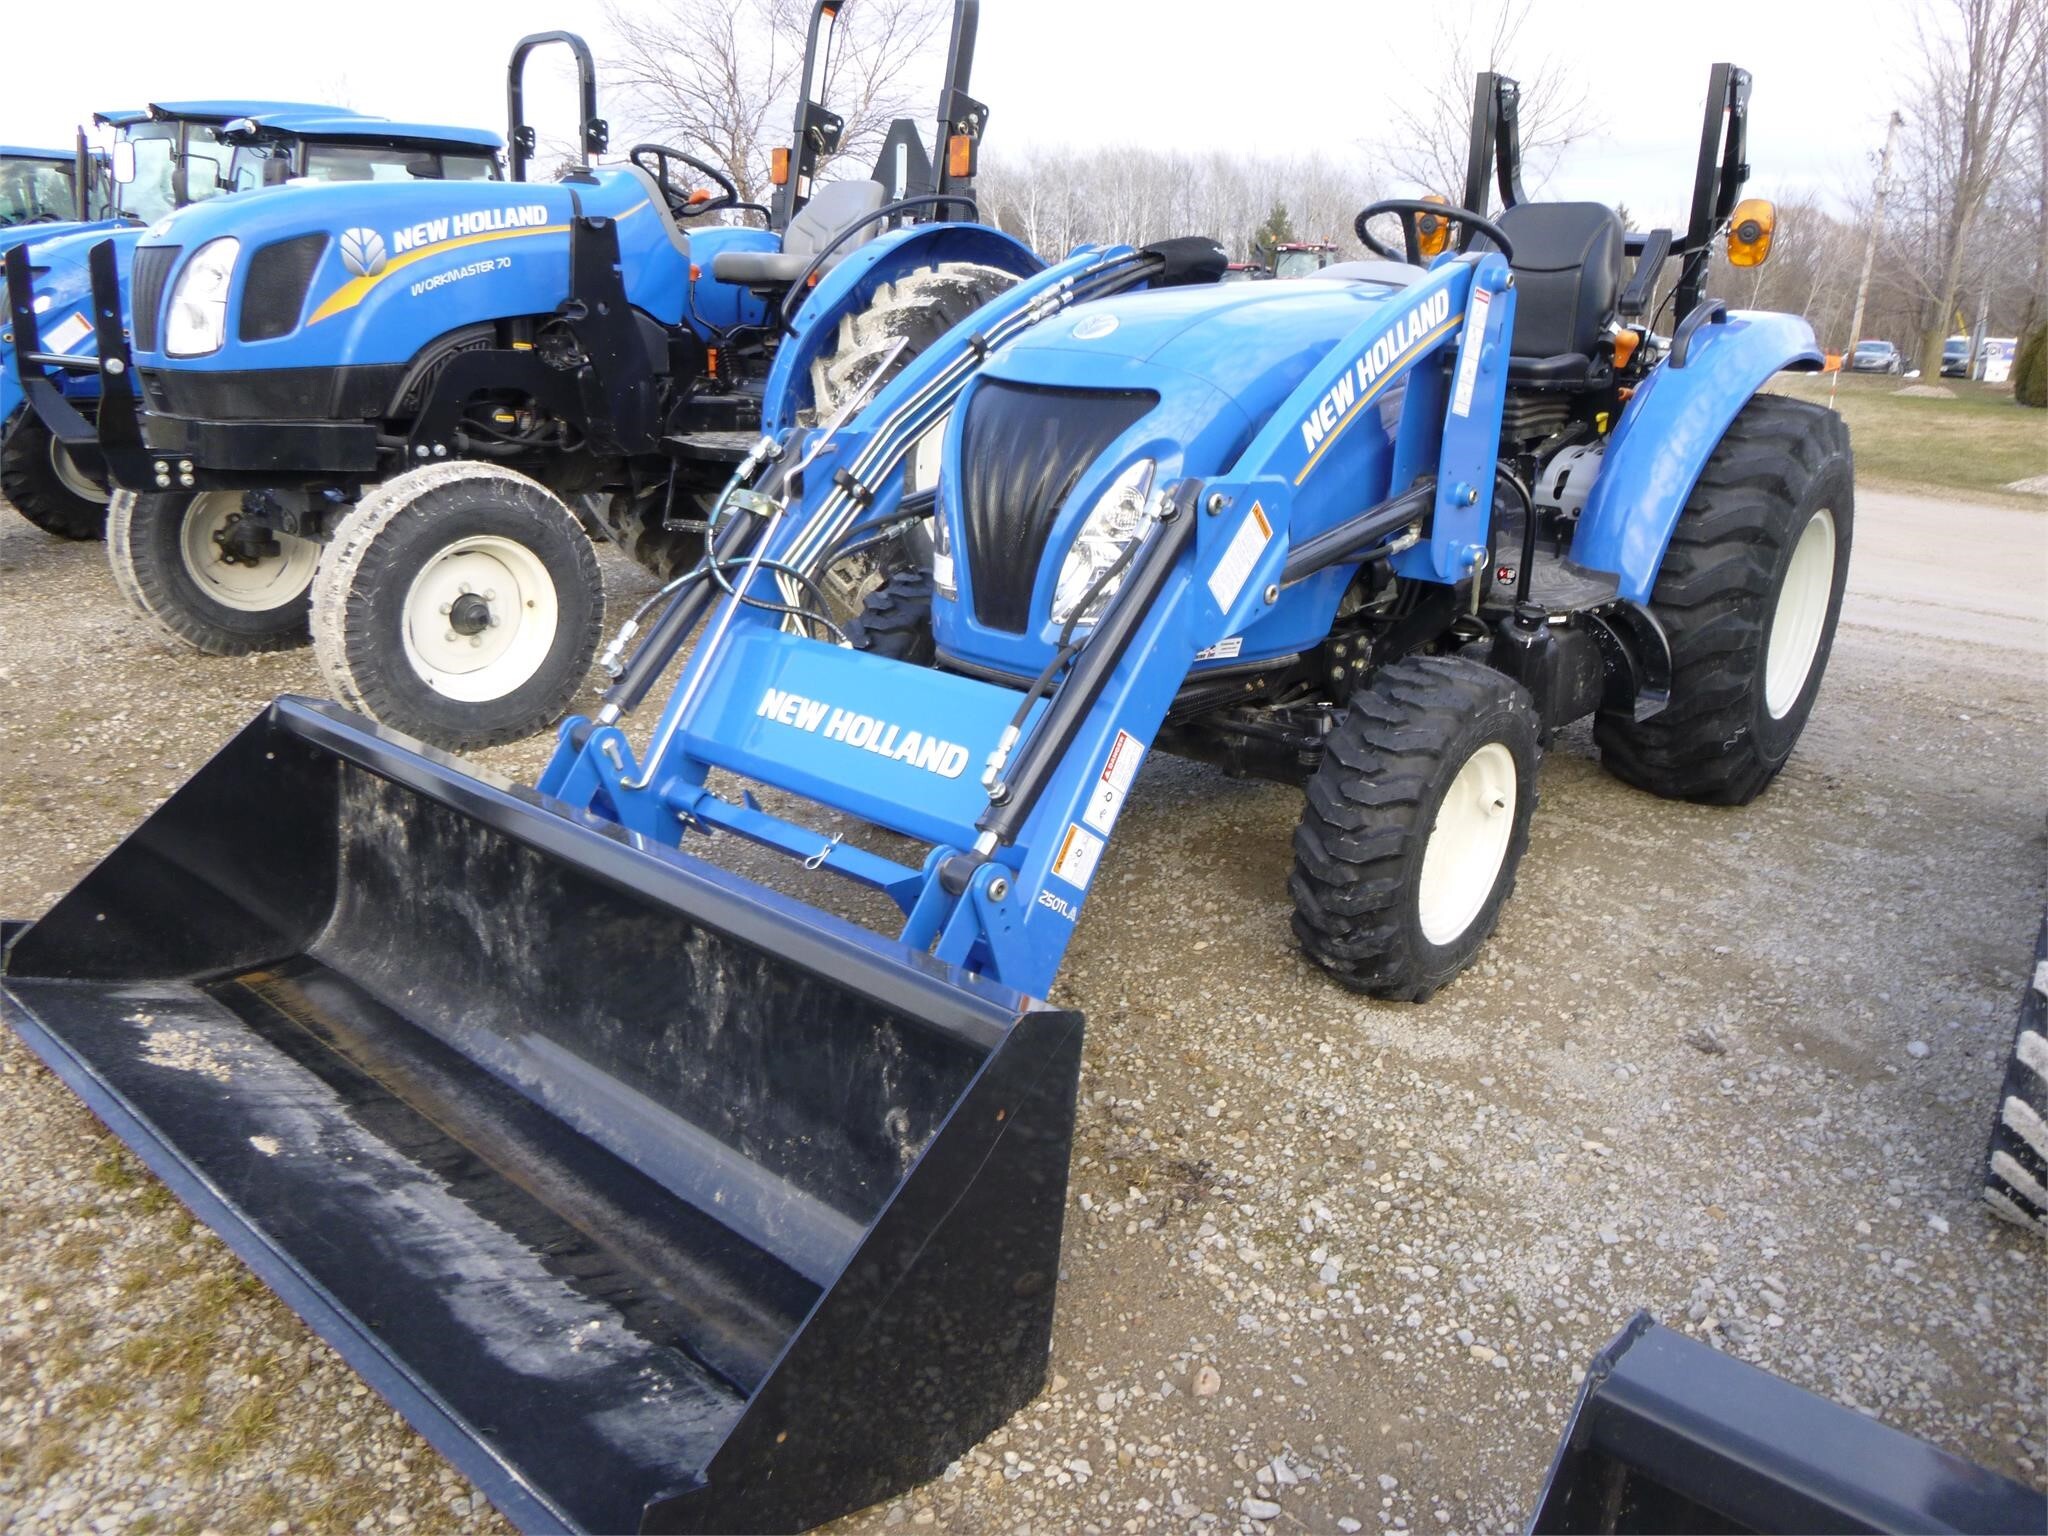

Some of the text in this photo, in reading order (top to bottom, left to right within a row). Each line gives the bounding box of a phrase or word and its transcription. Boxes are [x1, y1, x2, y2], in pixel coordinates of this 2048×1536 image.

[393, 205, 548, 253] NEW HOLLAND
[411, 257, 512, 297] WORKMASTER 70
[1301, 369, 1355, 454] NEW
[1355, 288, 1450, 392] HOLLAND
[756, 687, 970, 779] NEW HOLLAND
[1038, 890, 1078, 922] 250TLA
